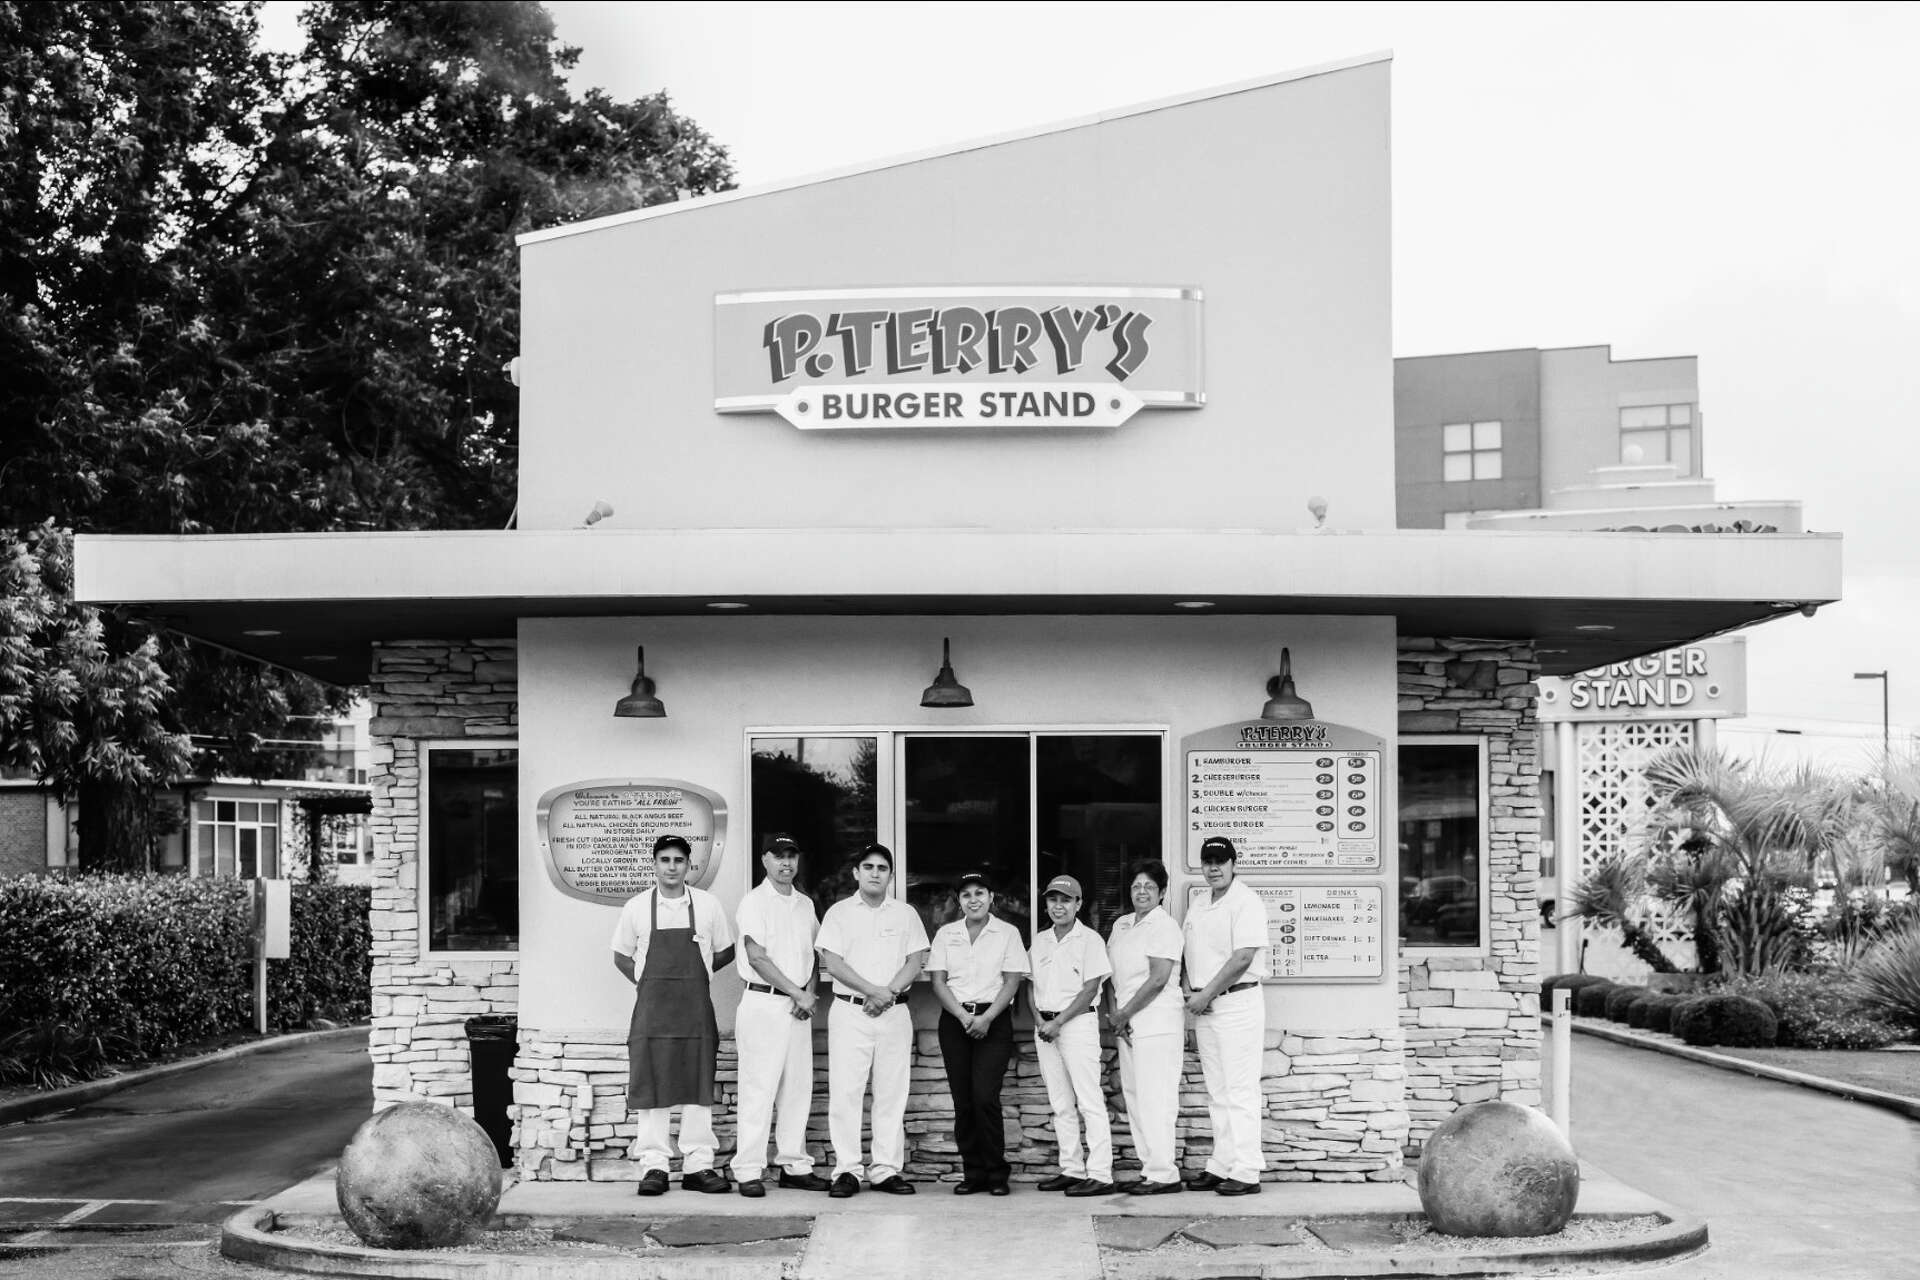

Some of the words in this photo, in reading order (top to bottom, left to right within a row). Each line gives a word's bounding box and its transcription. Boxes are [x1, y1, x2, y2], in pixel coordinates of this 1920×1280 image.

[762, 303, 1155, 384] P.TERRY'S
[821, 393, 965, 420] BURGER
[979, 390, 1097, 418] STAND
[1570, 678, 1695, 709] STAND
[1240, 725, 1328, 741] P.TERRY'S
[1194, 758, 1202, 767] 1.
[1191, 774, 1203, 783] 2.
[1192, 789, 1203, 799] 3.
[572, 799, 601, 807] YOU'RE
[1191, 805, 1203, 815] 4.
[1191, 821, 1203, 831] 5.
[552, 836, 575, 844] FRESH
